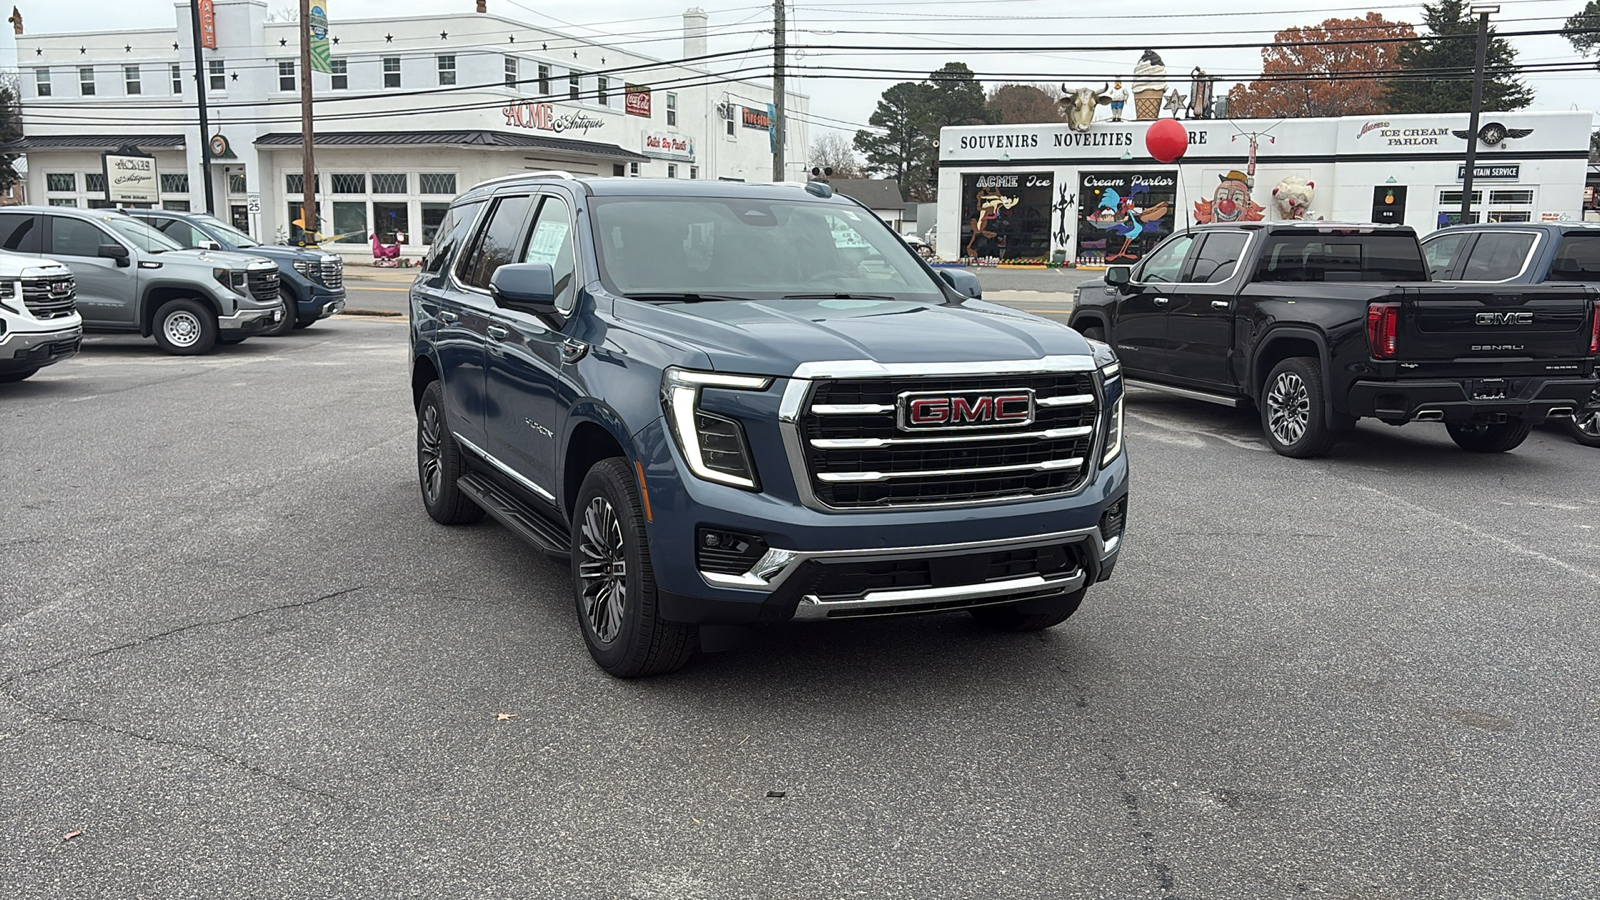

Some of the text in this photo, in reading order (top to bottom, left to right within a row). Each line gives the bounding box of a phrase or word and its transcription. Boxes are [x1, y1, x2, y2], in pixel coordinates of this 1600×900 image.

[204, 2, 213, 46] ACME
[502, 99, 554, 131] ACME
[1380, 123, 1449, 138] ICE CREAM
[662, 137, 671, 152] Boy
[960, 132, 1133, 150] SOUVENIRS NOVELTIES
[1387, 138, 1438, 146] PARLOR
[115, 159, 151, 171] ACME
[1460, 167, 1518, 177] FNTAIN SERVICE
[976, 174, 1175, 188] ACME Ice Cream Parlor
[249, 203, 260, 212] 25
[1475, 312, 1534, 325] GMC
[911, 395, 1030, 424] GMC
